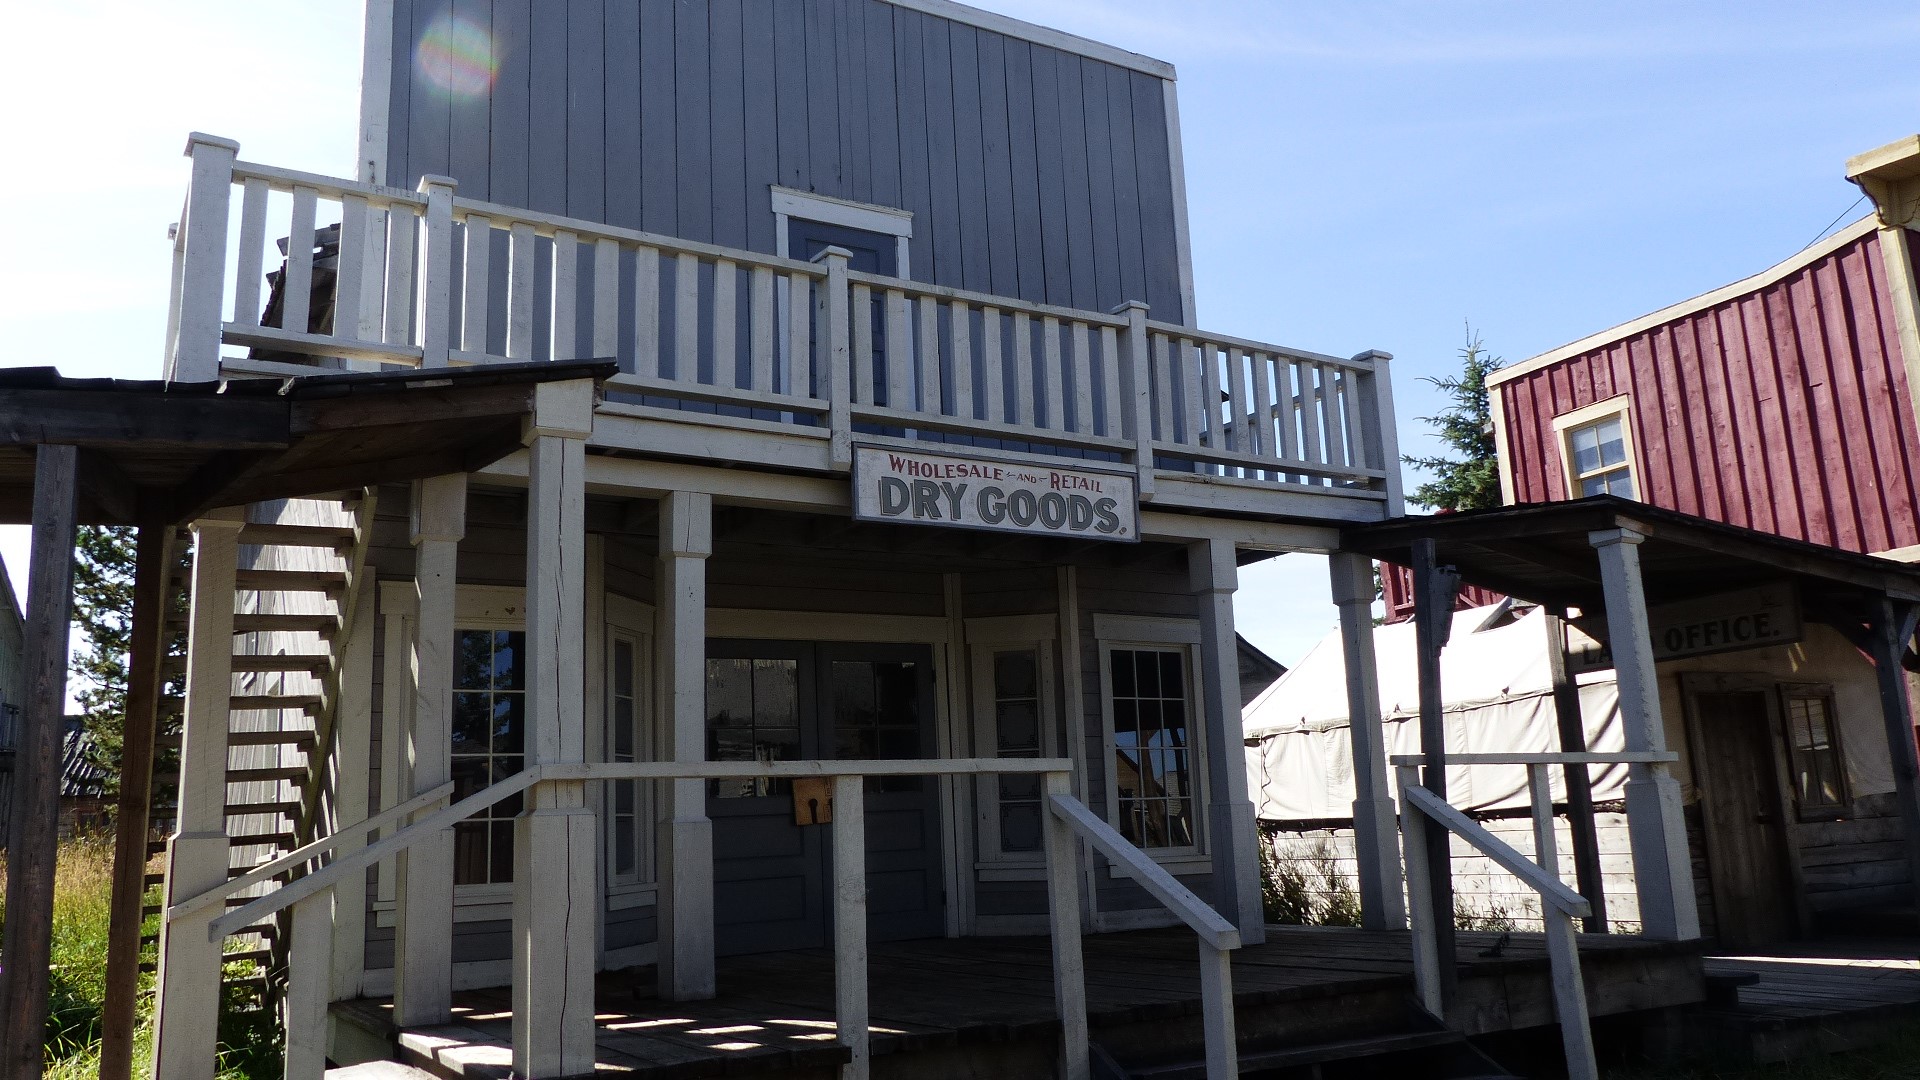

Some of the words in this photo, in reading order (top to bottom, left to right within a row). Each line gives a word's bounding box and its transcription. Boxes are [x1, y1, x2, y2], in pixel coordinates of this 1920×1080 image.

[888, 454, 1004, 480] WHOLESALE
[1050, 472, 1103, 493] RETAIL
[878, 476, 968, 521] DRY
[977, 486, 1127, 535] GOODS.
[1664, 612, 1780, 652] OFFICE.
